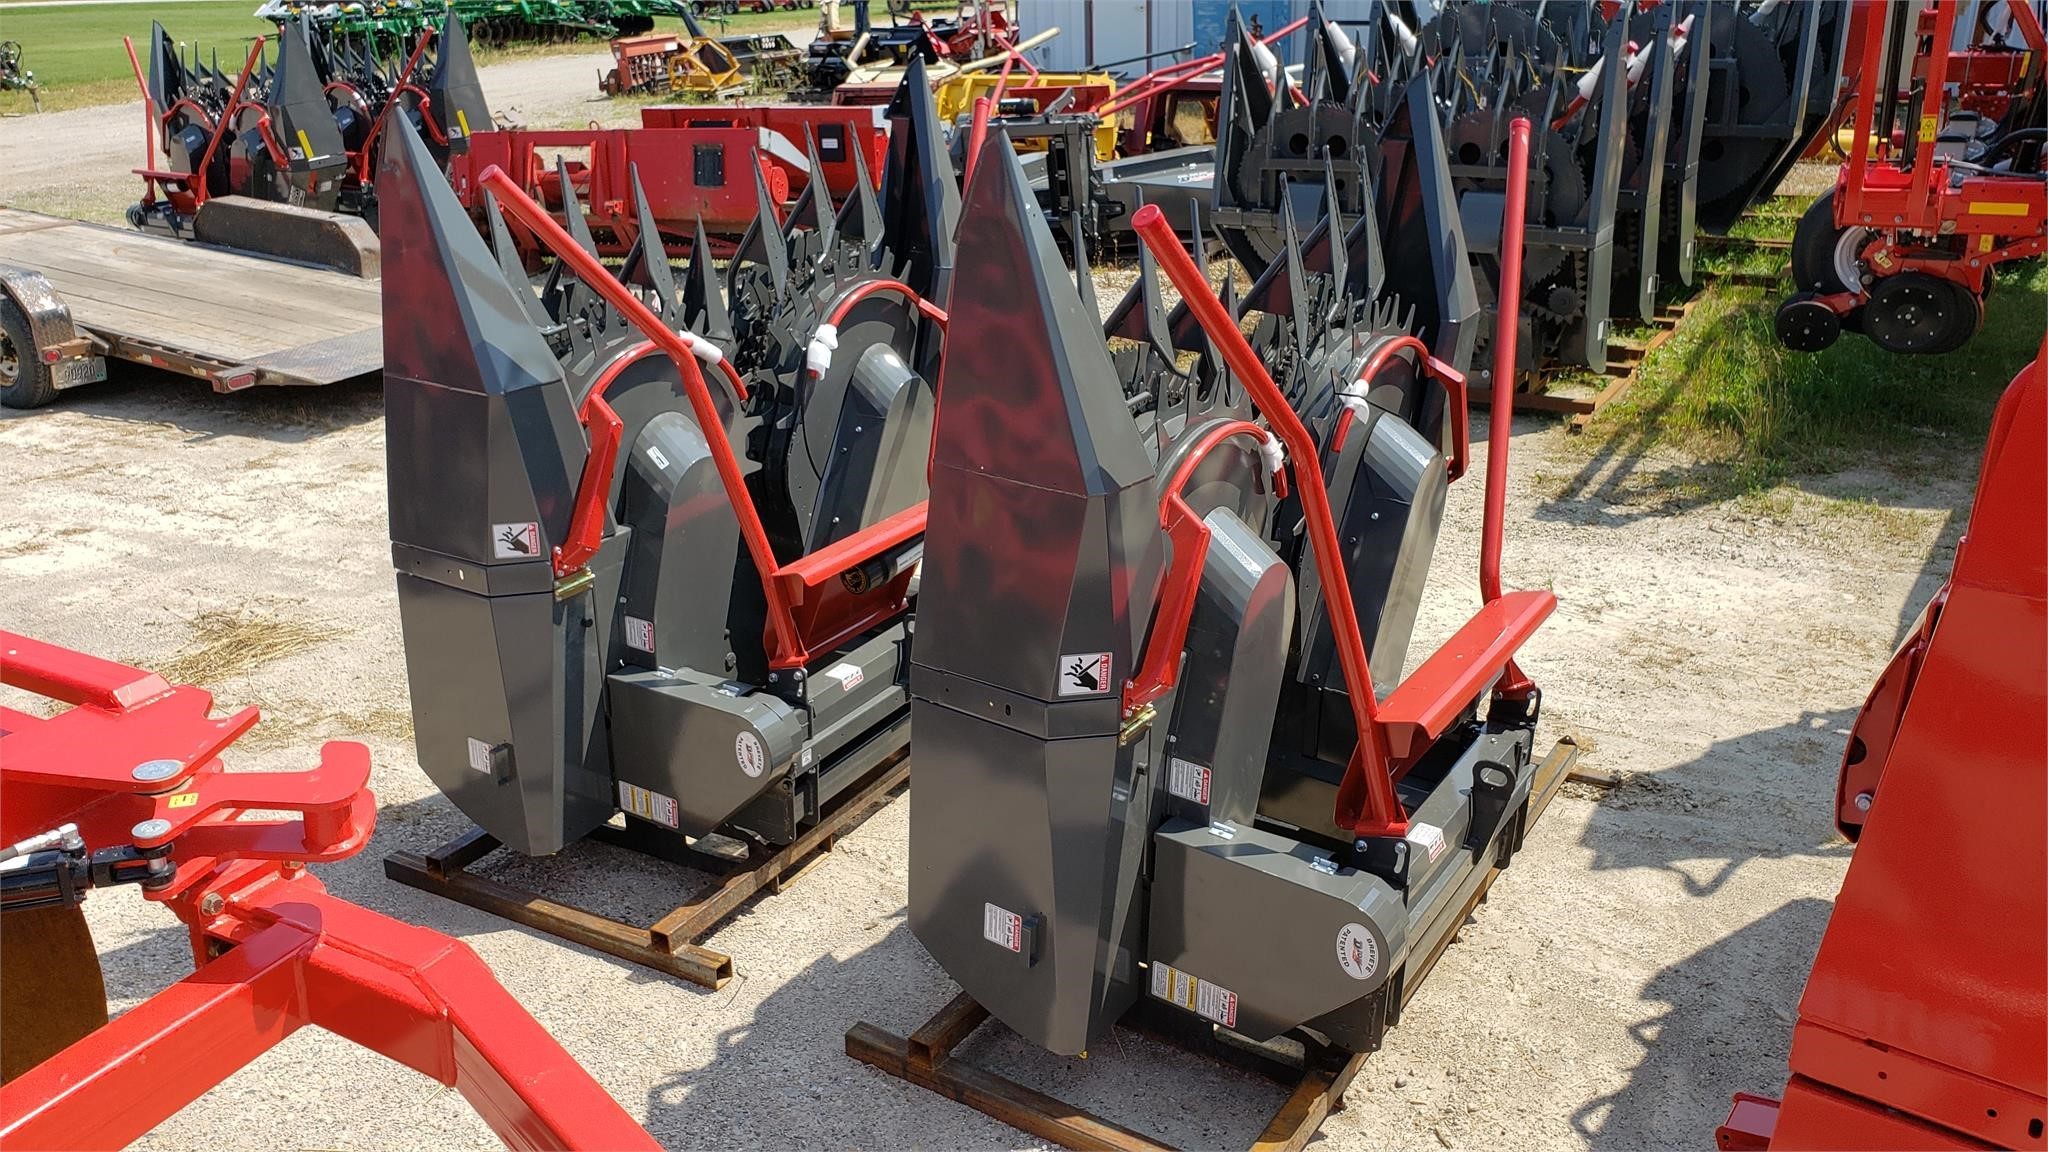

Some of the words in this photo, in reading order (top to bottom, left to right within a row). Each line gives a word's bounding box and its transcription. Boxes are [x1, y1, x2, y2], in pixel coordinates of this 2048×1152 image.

[1100, 663, 1108, 690] DANGER
[738, 736, 748, 769] PATENTED
[1340, 928, 1352, 968] PATENTED
[1365, 937, 1376, 973] BREVETE
